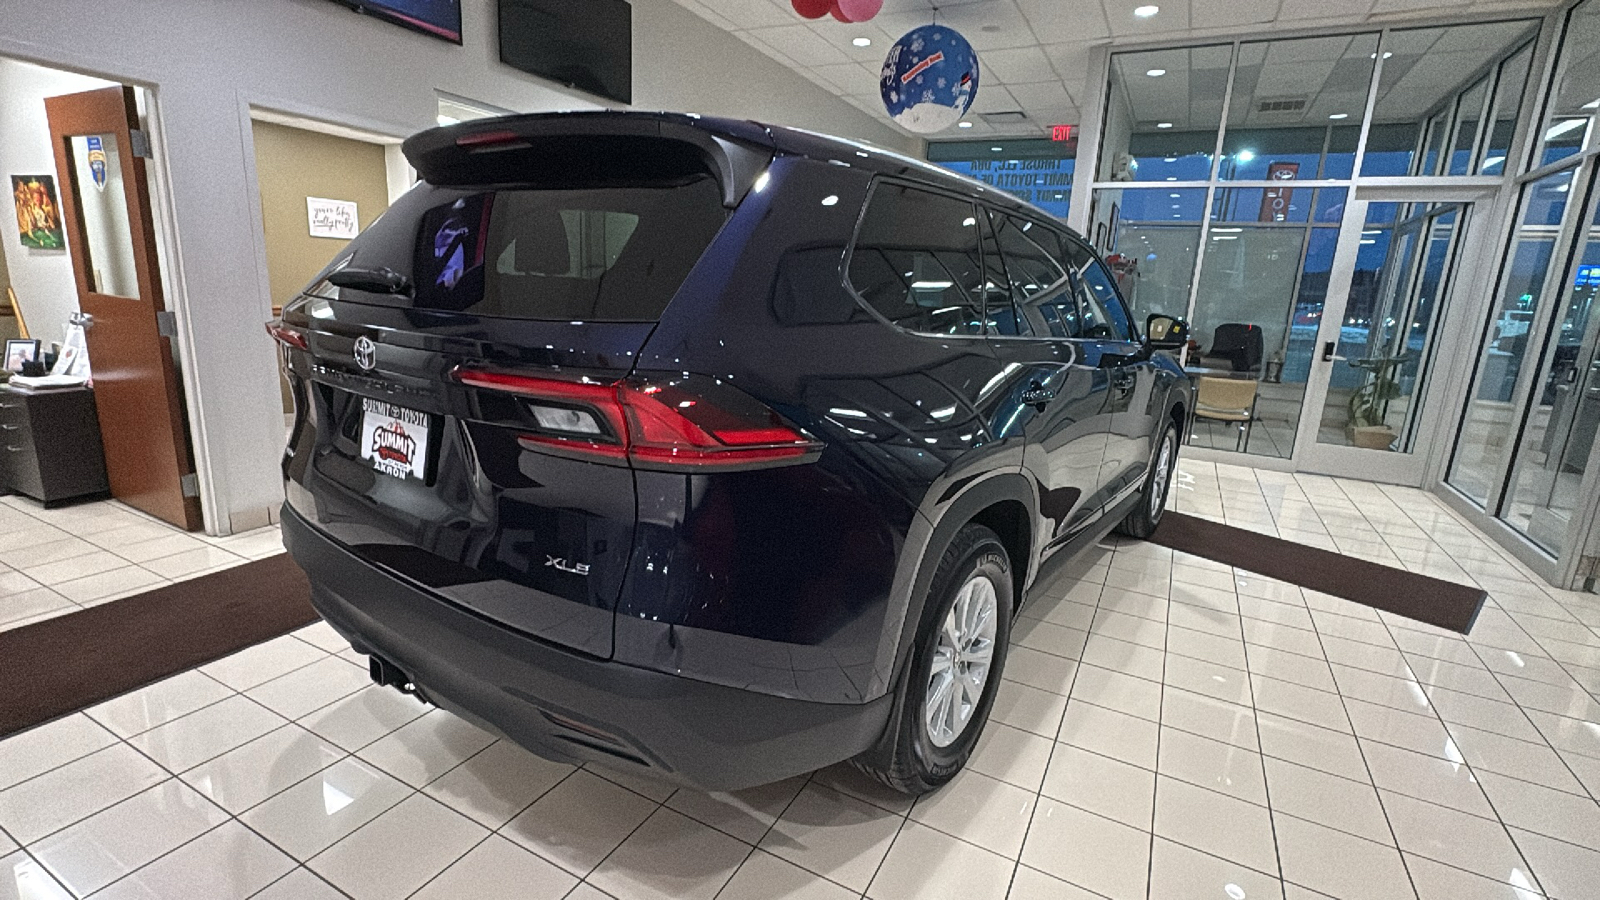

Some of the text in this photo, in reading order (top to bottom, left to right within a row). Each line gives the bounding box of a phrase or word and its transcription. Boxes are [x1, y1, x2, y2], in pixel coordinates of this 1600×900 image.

[1052, 126, 1071, 141] EXIT
[362, 397, 428, 428] SUMMIT TOYOTA
[373, 427, 416, 464] SUMMIT
[373, 461, 406, 480] AKRON
